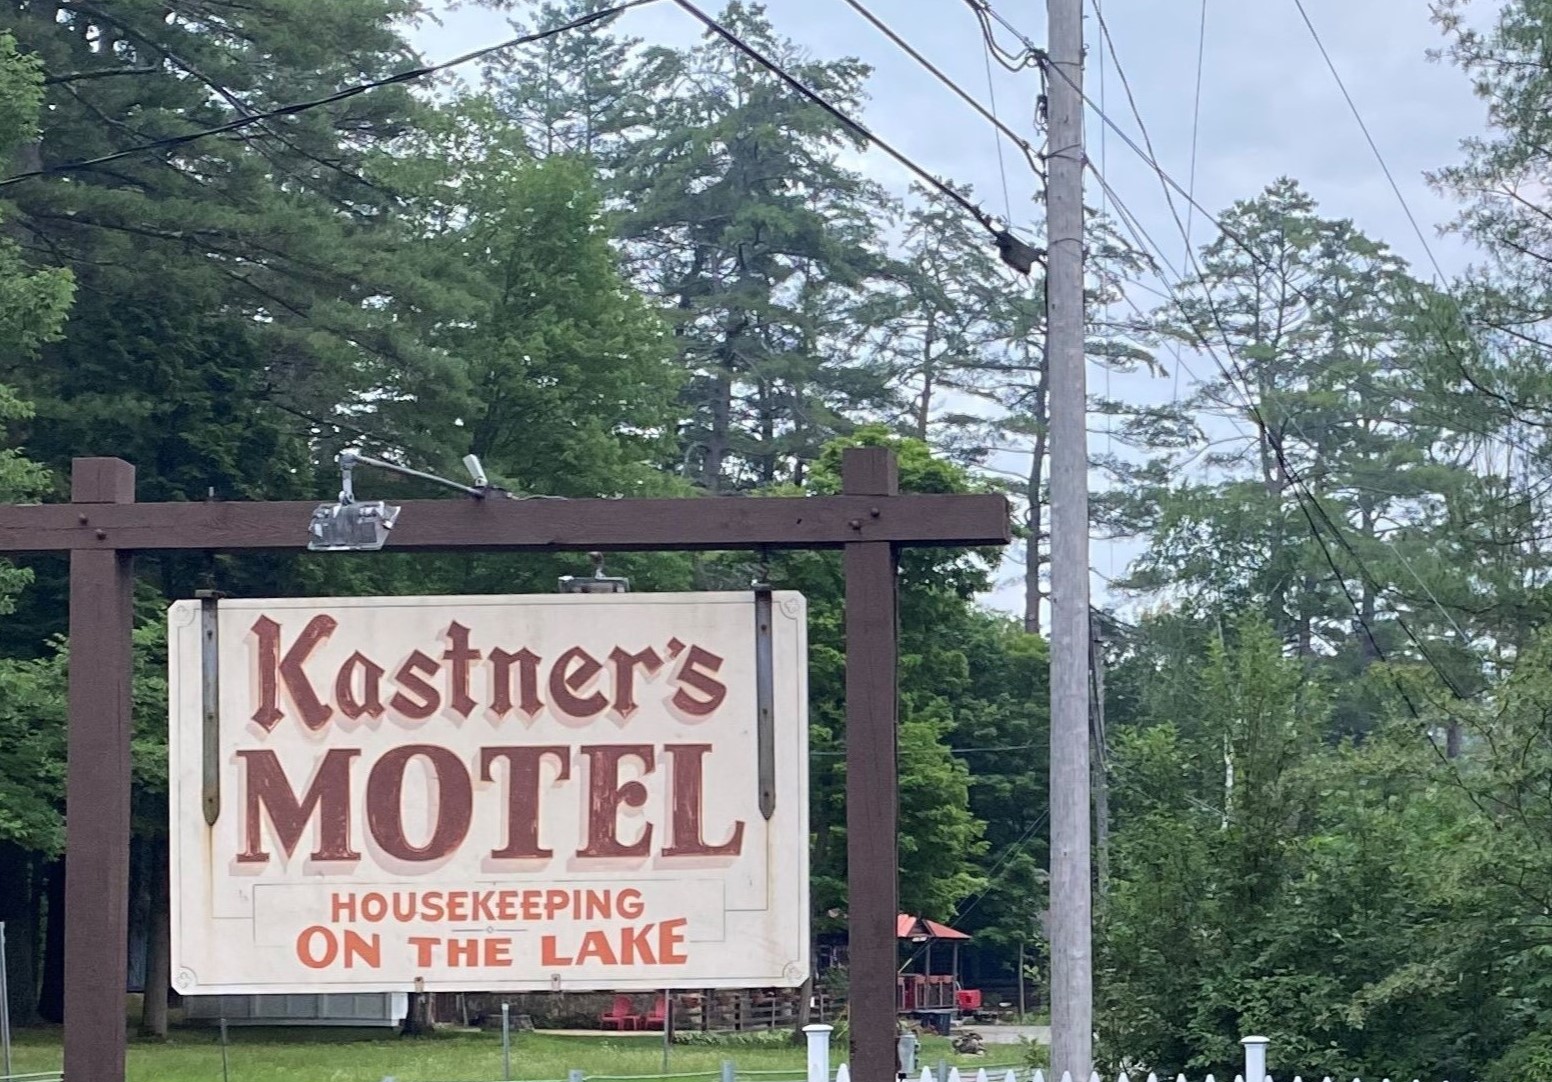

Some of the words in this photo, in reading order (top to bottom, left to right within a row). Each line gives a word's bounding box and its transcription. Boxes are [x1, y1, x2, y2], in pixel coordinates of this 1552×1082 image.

[250, 613, 728, 733] Kastner's
[235, 743, 745, 864] MOTEL
[296, 925, 381, 969] ON
[407, 935, 513, 968] THE
[540, 917, 689, 967] LAKE
[330, 887, 645, 923] HOUSEKEEPING
